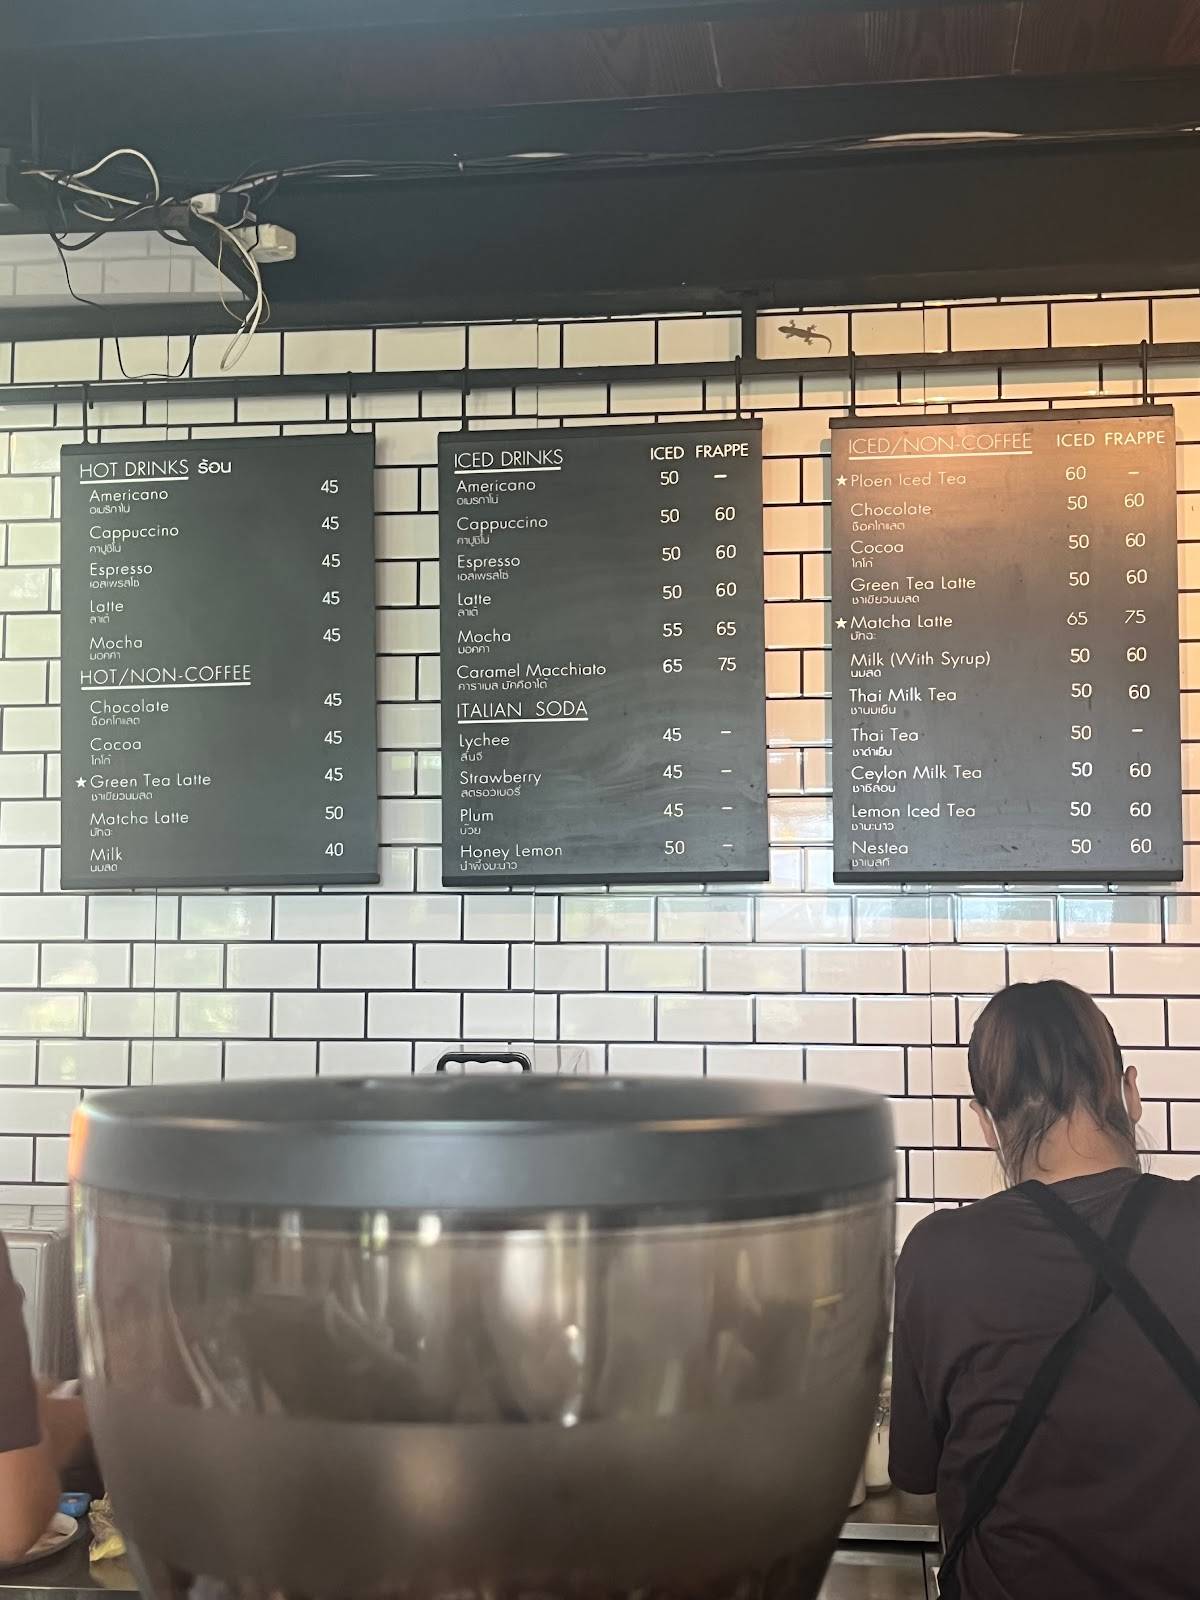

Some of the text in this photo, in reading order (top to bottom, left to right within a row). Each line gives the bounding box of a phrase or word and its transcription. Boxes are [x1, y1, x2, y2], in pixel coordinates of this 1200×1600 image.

[848, 432, 1032, 455] ICED/NON-COFFEE
[1057, 431, 1165, 447] ICED FRAPPE
[455, 449, 563, 468] ICED DRINKS
[651, 443, 748, 460] ICED FRAPPE
[81, 459, 188, 478] HOT DRINKS
[198, 459, 231, 474] ร้อน
[1066, 466, 1086, 480] 60
[661, 471, 678, 485] 50
[851, 472, 966, 487] Ploen Iced Tea
[321, 480, 338, 493] 45
[457, 480, 535, 492] Americano
[90, 490, 168, 502] Americano
[1067, 493, 1144, 510] 50 60
[661, 507, 735, 523] 50 60
[851, 502, 931, 516] Chocolate
[322, 516, 339, 530] 45
[457, 517, 547, 535] Cappuccino
[90, 526, 178, 543] Cappuccino
[1069, 533, 1145, 549] 50 60
[662, 545, 736, 561] 50 60
[851, 540, 903, 554] Cocoa
[322, 554, 340, 567] 45
[458, 555, 520, 569] Espresso
[91, 563, 152, 579] Espresso
[1069, 569, 1147, 586] 50 60
[663, 582, 736, 599] 50 60
[851, 576, 975, 591] Green Tea Latte
[322, 591, 340, 604] 45
[458, 593, 491, 605] Latte
[91, 600, 123, 612] Latte
[851, 614, 952, 629] Matcha Latte
[1067, 610, 1145, 625] 65 75
[323, 628, 340, 642] 45
[458, 629, 510, 643] Mocha
[663, 622, 736, 637] 55 65
[90, 635, 142, 649] Mocha
[851, 651, 990, 669] Milk (With Syrup)
[1070, 647, 1146, 663] 50 60
[457, 662, 606, 678] Caramel Macchiato
[663, 657, 736, 673] 65 75
[81, 665, 251, 686] HOT/NON-COFFEE
[851, 669, 881, 677] นมสด
[459, 681, 500, 690] คาราเมล
[1072, 683, 1150, 699] 50 60
[324, 693, 342, 706] 45
[849, 687, 956, 702] Thai Milk Tea
[91, 699, 168, 714] Chocolate
[458, 701, 587, 718] ITALIAN SODA
[851, 704, 896, 714] ชานมเย็น
[324, 731, 342, 744] 45
[663, 728, 681, 741] 45
[851, 728, 918, 741] Thai Tea
[1071, 726, 1091, 740] 50
[90, 738, 141, 751] Cocoa
[460, 732, 509, 751] Lychee
[853, 746, 892, 756] ชาดำเย็น
[325, 768, 343, 781] 45
[663, 765, 682, 778] 45
[851, 765, 981, 783] Ceylon Milk Tea
[1072, 762, 1151, 777] 50 60
[91, 774, 210, 788] Green Tea Latte
[460, 769, 541, 785] Strawberry
[326, 806, 343, 819] 50
[461, 808, 493, 822] Plum
[664, 803, 683, 817] 45
[853, 803, 975, 817] Lemon Iced Tea
[1070, 802, 1151, 817] 50 60
[90, 811, 188, 825] Matcha Latte
[325, 843, 343, 856] 40
[461, 844, 562, 861] Honey Lemon
[665, 841, 684, 854] 50
[853, 841, 908, 854] Nestea
[1072, 839, 1151, 853] 50 60
[91, 847, 122, 861] Milk
[91, 864, 117, 872] นมสด
